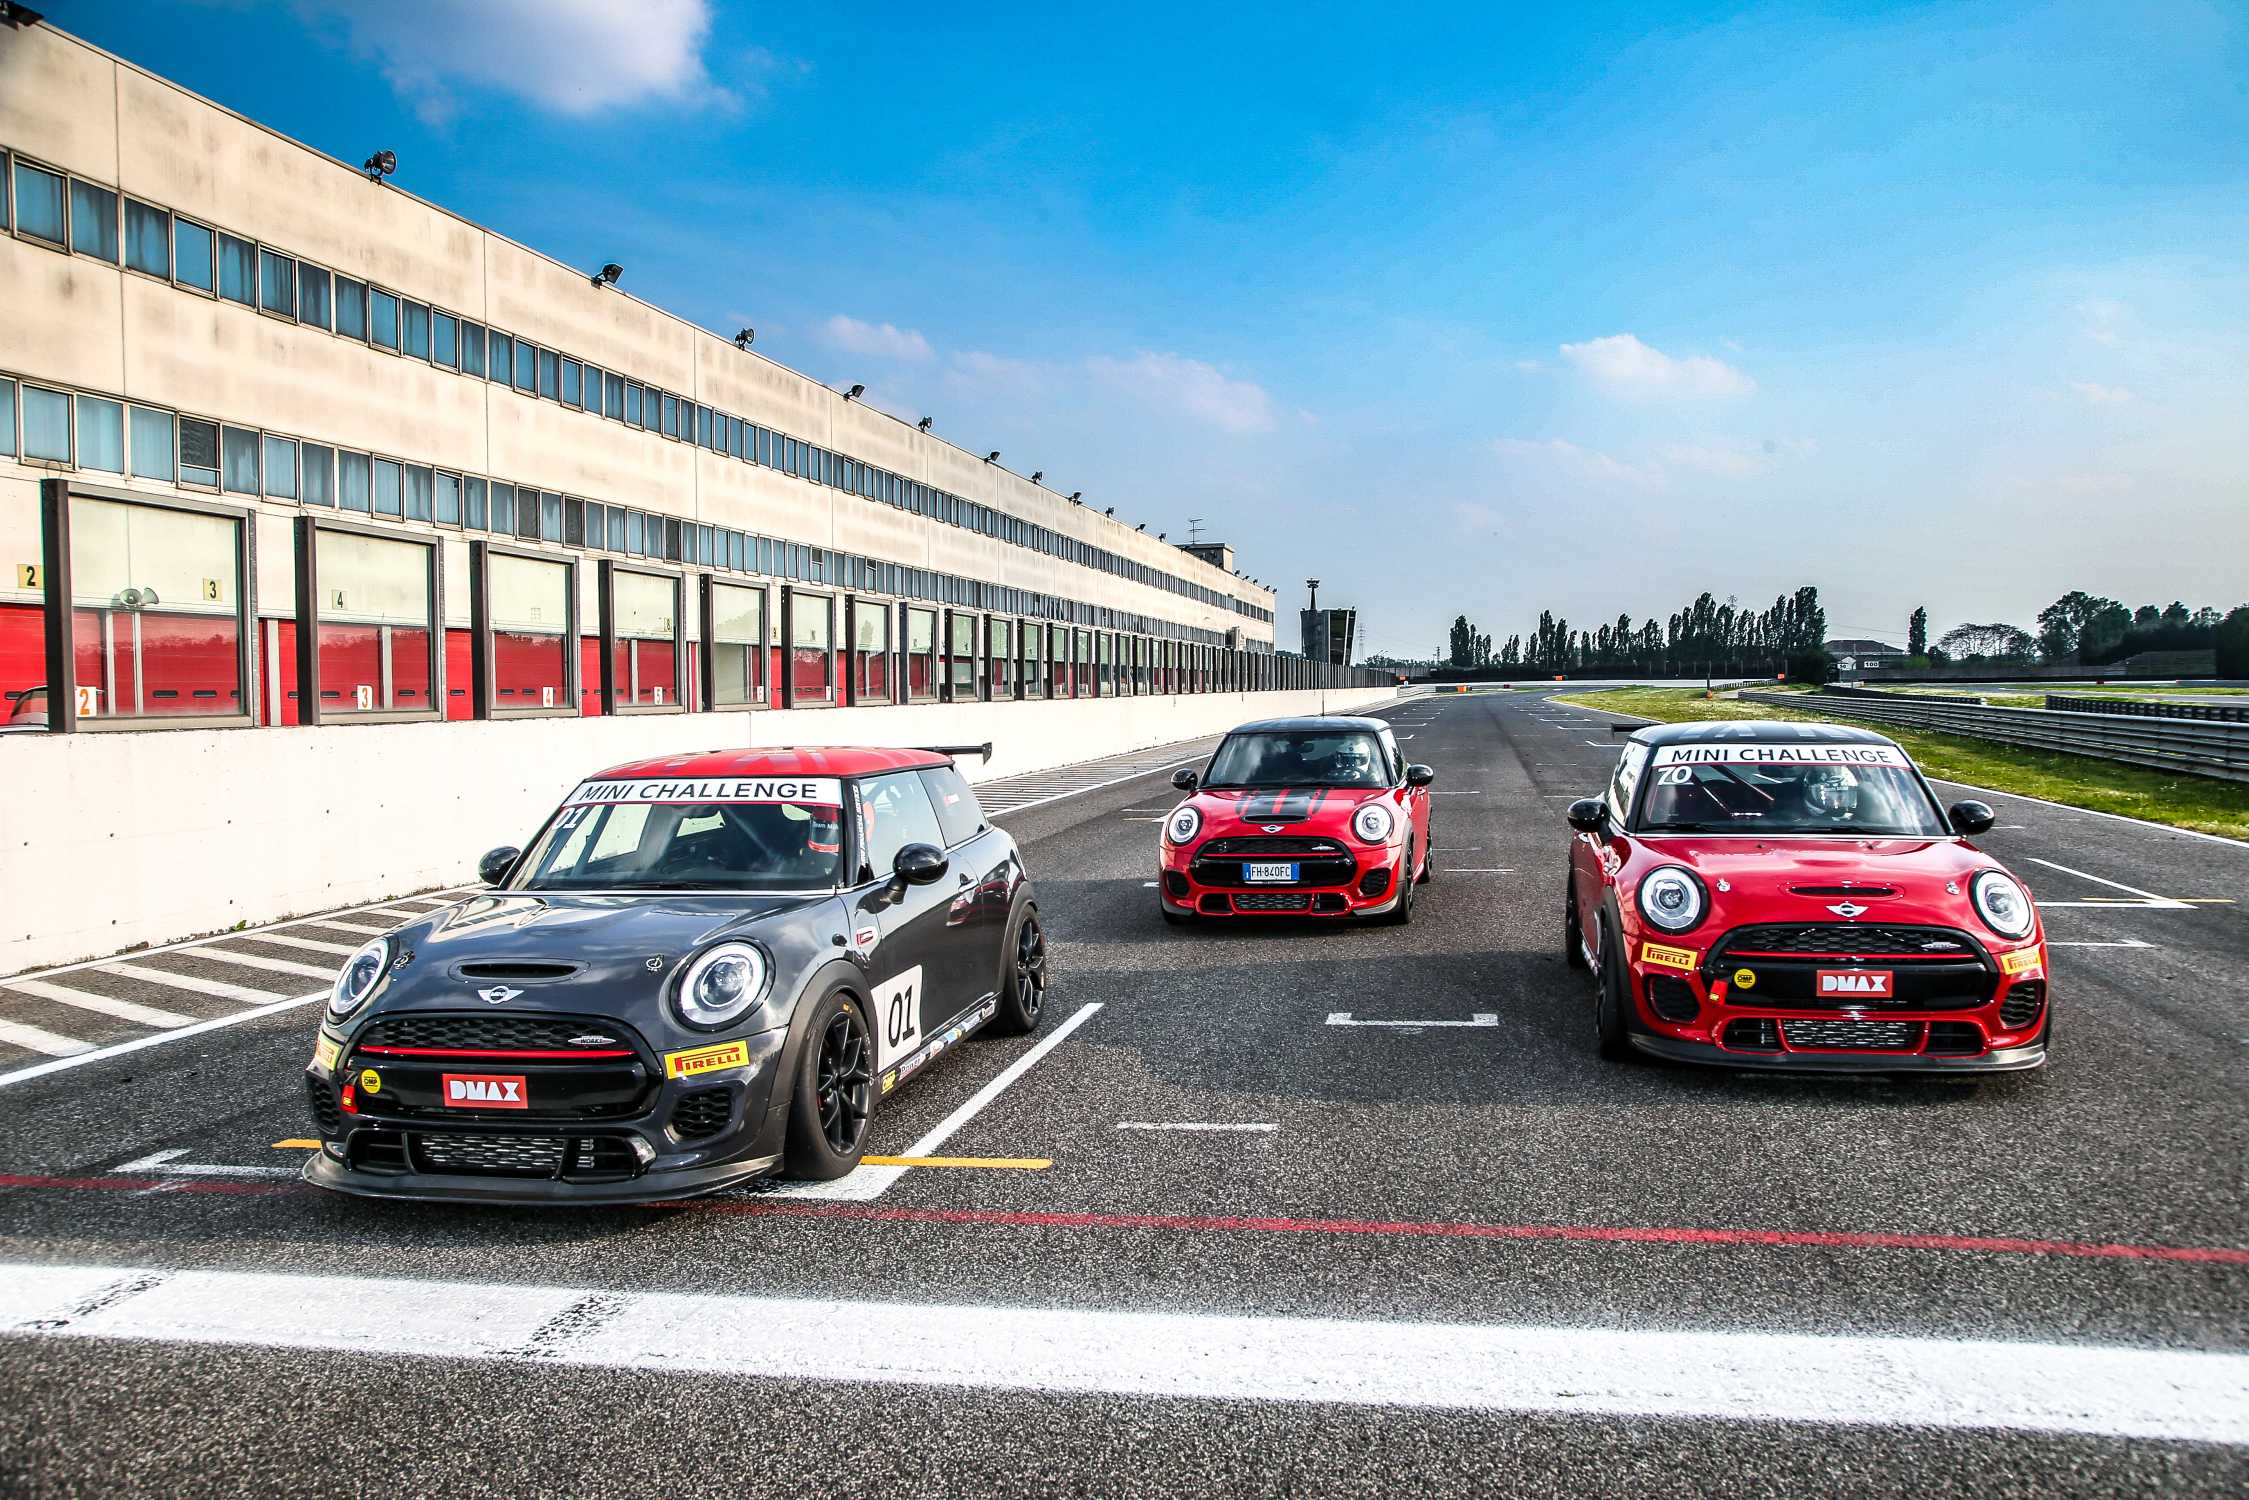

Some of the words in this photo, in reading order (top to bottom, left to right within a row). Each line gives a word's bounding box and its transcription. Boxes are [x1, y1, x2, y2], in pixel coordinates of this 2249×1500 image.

[26, 565, 36, 587] 2
[209, 580, 217, 599] 3
[337, 591, 344, 608] 4
[79, 688, 90, 716] 2
[361, 687, 369, 708] 3
[1672, 748, 1728, 763] MINI
[1739, 748, 1890, 764] CHALLENGE
[1658, 766, 1694, 785] 70
[579, 784, 634, 800] MINI
[639, 783, 818, 799] CHALLENGE
[552, 806, 585, 830] 01
[1647, 946, 1690, 966] PIRELLI
[1822, 975, 1887, 992] DMAX
[888, 984, 915, 1048] 01
[674, 1047, 740, 1071] PIRELLI
[450, 1080, 520, 1102] DMAX
